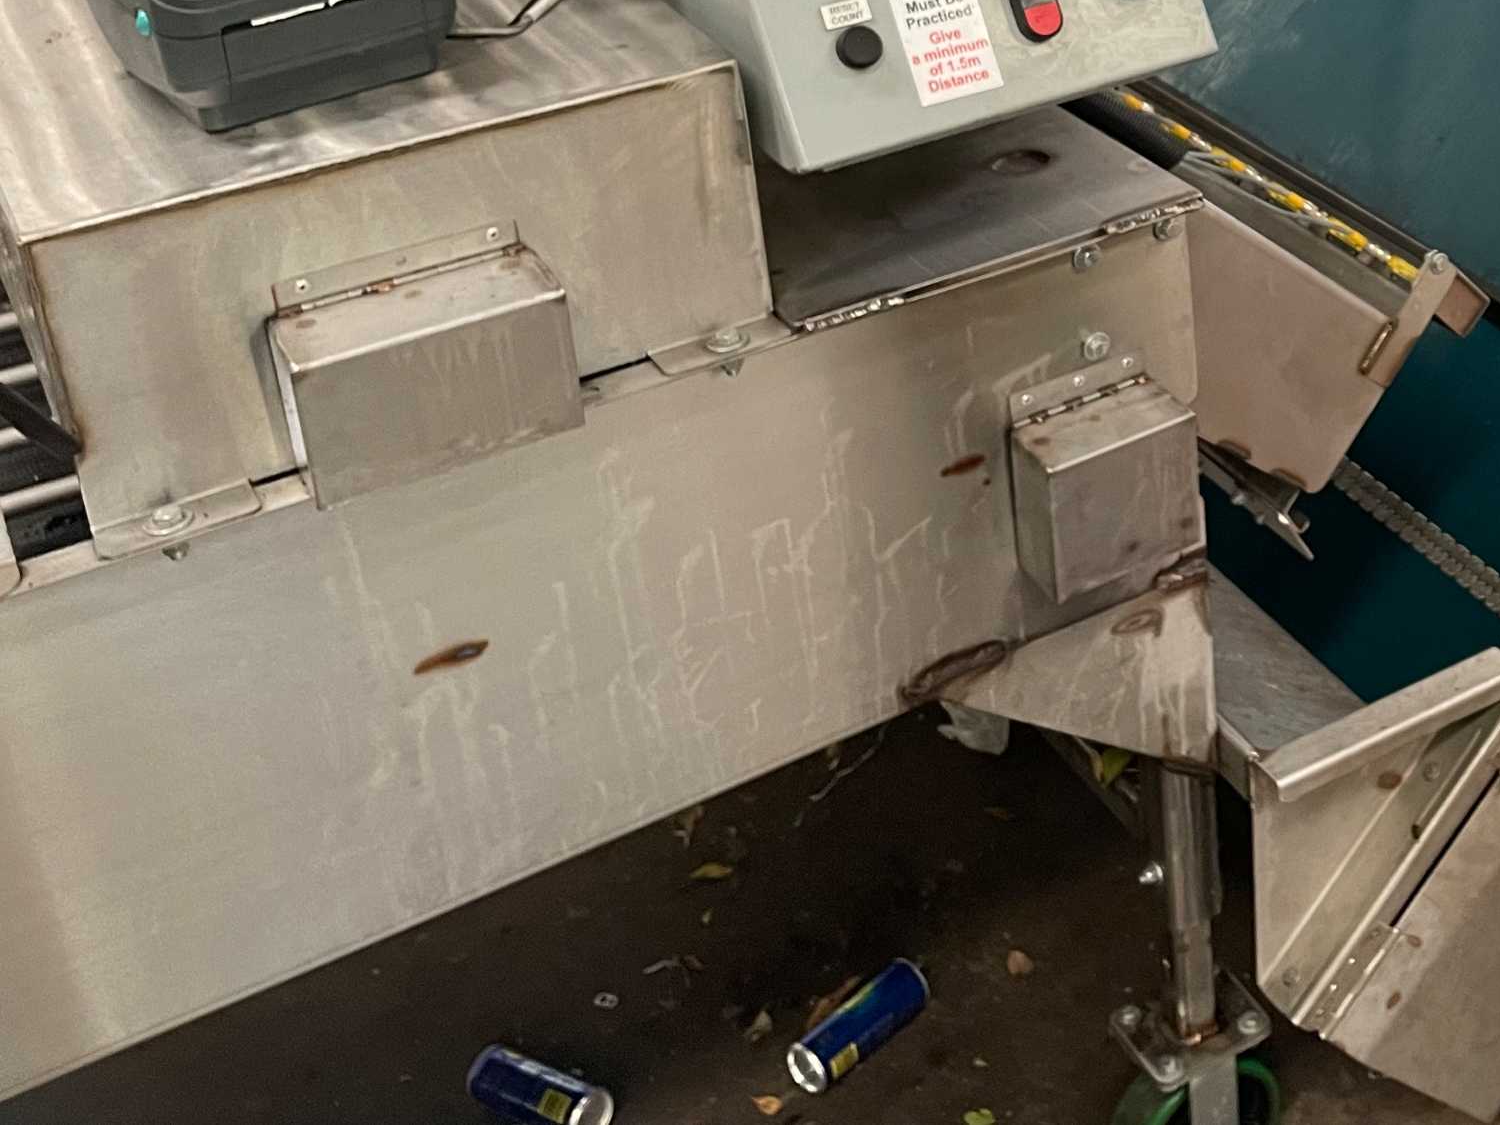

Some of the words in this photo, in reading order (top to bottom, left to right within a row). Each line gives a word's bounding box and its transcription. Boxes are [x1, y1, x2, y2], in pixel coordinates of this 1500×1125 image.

[905, 5, 973, 30] Practiced
[928, 28, 961, 45] Give
[911, 54, 921, 66] a
[924, 38, 989, 63] minimum
[929, 62, 943, 77] of
[948, 56, 982, 73] 1.5m
[928, 69, 990, 94] Distance
